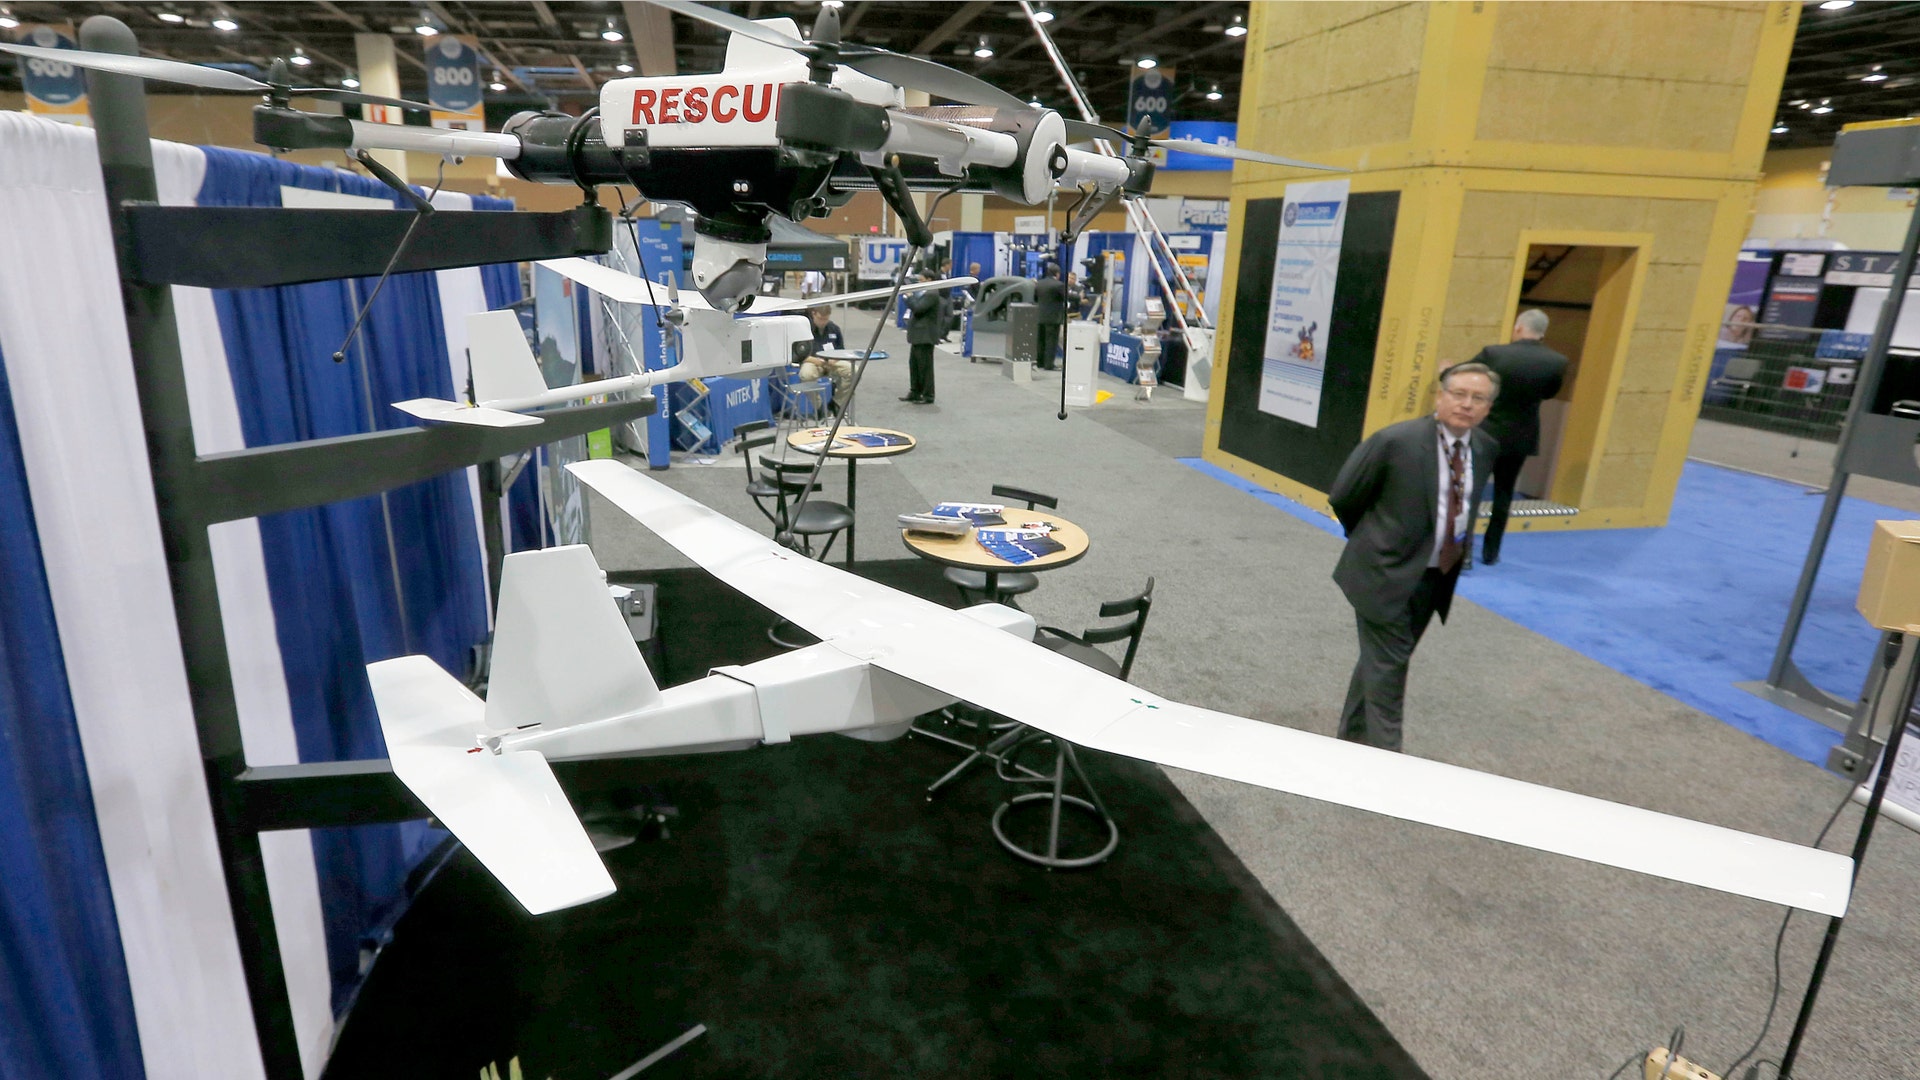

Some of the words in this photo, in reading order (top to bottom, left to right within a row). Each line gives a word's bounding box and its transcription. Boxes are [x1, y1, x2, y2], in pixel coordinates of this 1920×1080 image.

[28, 59, 74, 78] 900
[434, 67, 473, 86] 800
[1135, 96, 1167, 113] 600
[768, 253, 803, 262] cameras
[1405, 376, 1420, 414] TOWER
